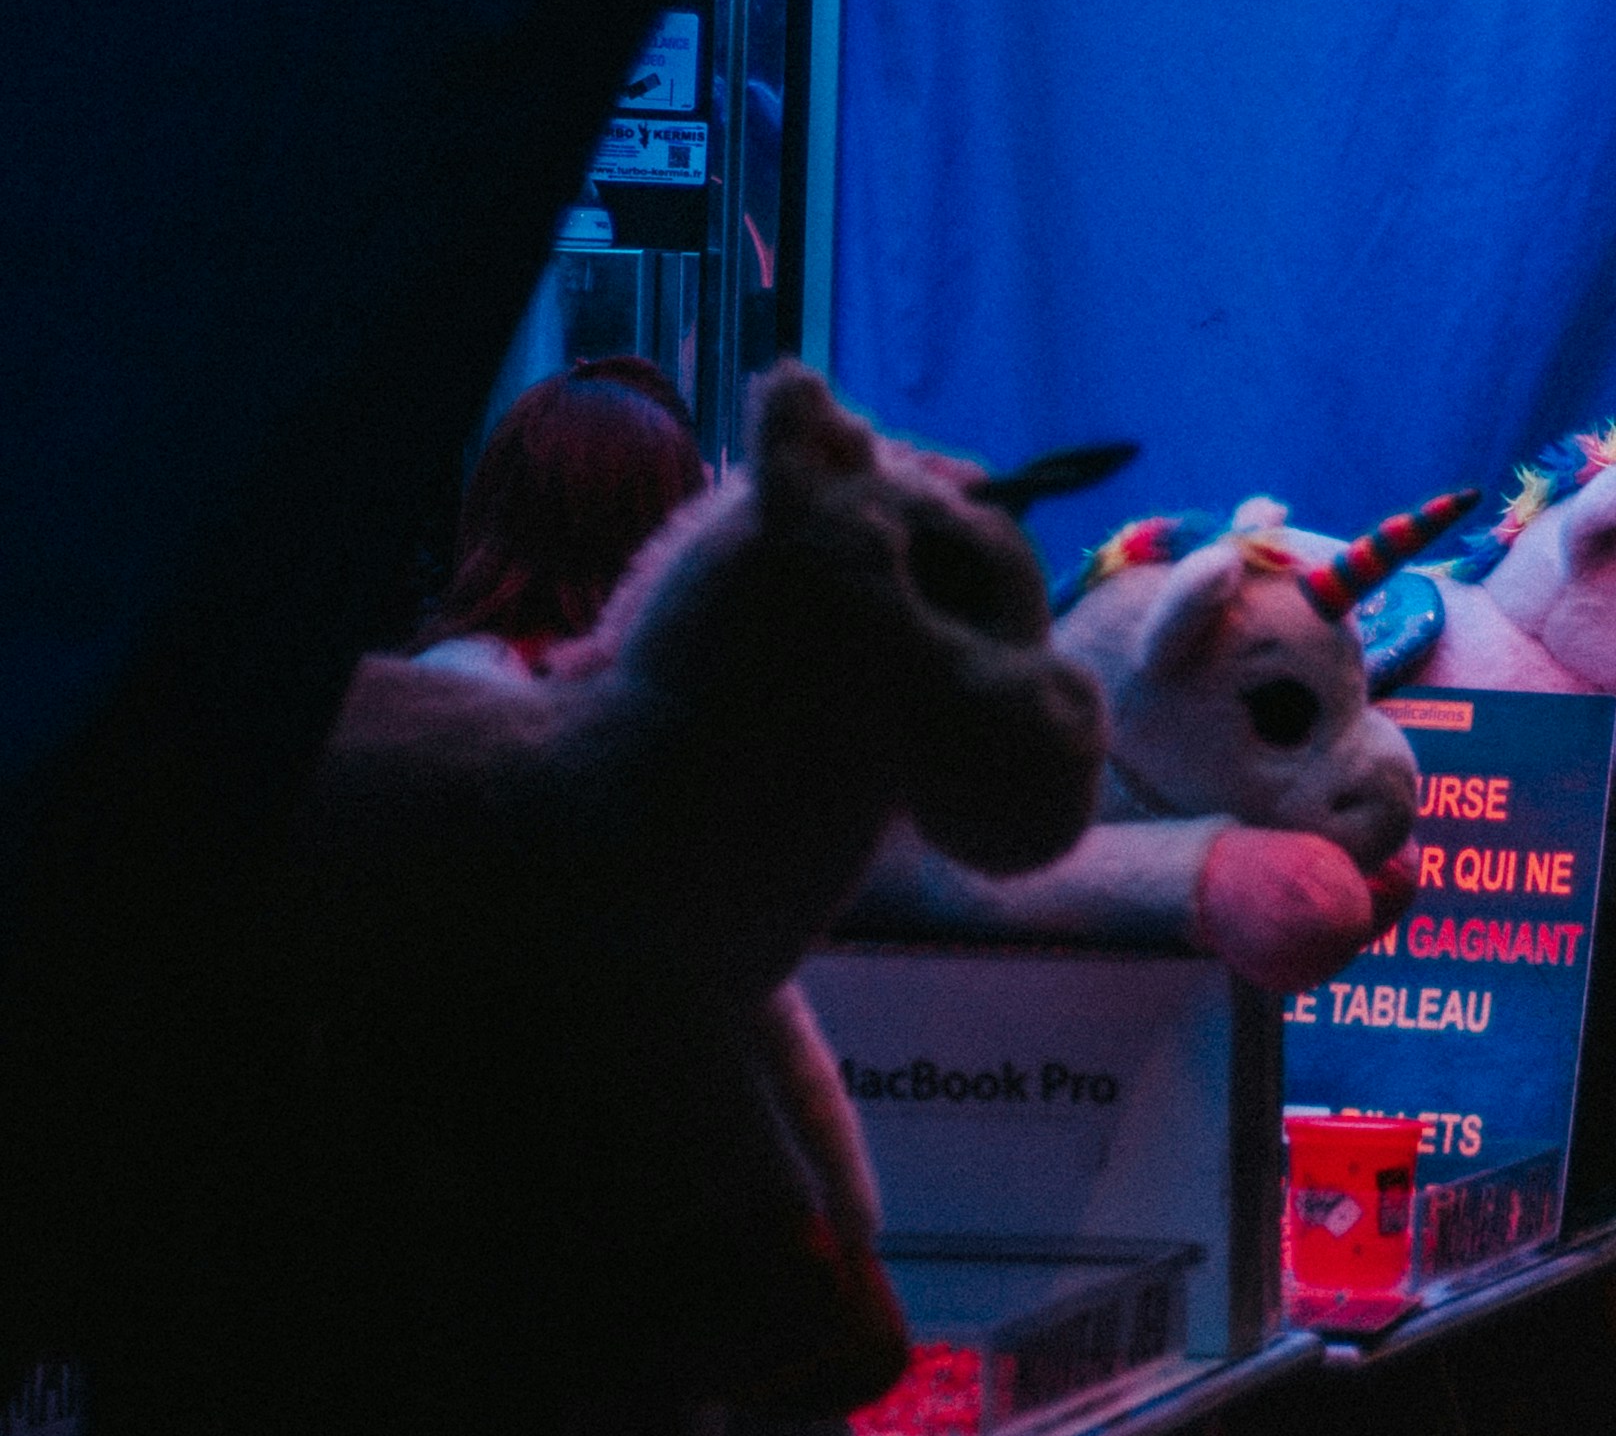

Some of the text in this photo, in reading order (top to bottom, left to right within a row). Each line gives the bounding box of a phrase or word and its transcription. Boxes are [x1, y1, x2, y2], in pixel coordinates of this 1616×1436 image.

[653, 130, 705, 143] KERMIS
[1454, 847, 1517, 894] QUI
[1523, 851, 1575, 895] NE
[1406, 914, 1584, 968] GAGNANT
[1328, 981, 1492, 1033] TABLEAU
[1040, 1062, 1119, 1104] Pro
